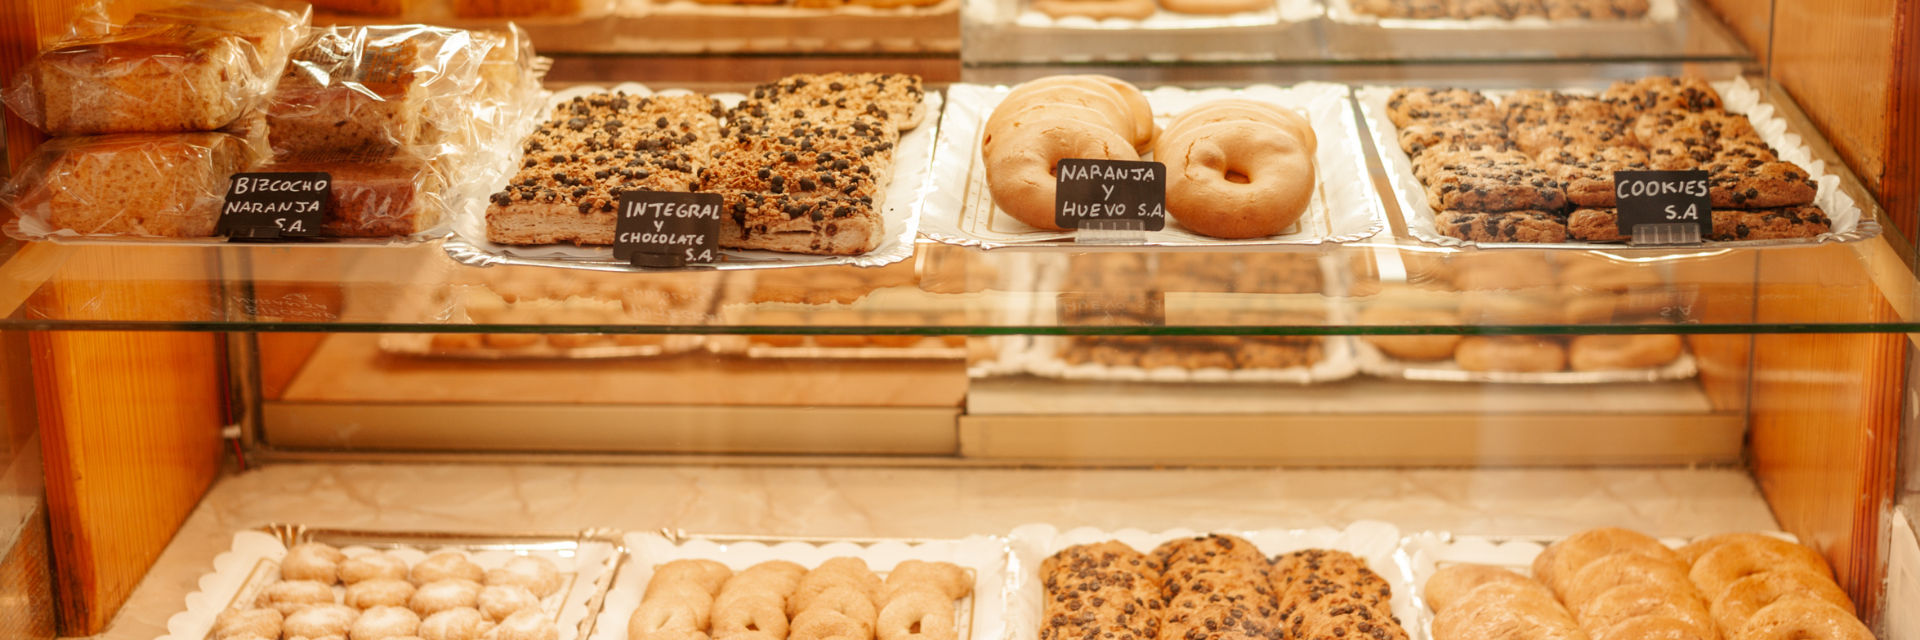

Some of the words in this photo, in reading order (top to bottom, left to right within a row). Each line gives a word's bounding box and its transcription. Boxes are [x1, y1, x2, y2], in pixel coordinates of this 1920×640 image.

[1060, 164, 1155, 183] NARANJA
[234, 176, 328, 195] BIZCOCHO
[1101, 184, 1114, 201] Y
[1616, 180, 1708, 199] COOKIES
[225, 200, 320, 215] NARANJA
[626, 200, 720, 220] INTEGRAL
[1062, 200, 1126, 217] HUEVO
[1137, 203, 1164, 218] S.A.
[274, 217, 307, 232] S.A.
[653, 220, 664, 232] Y
[619, 232, 705, 246] CHOCOLATE
